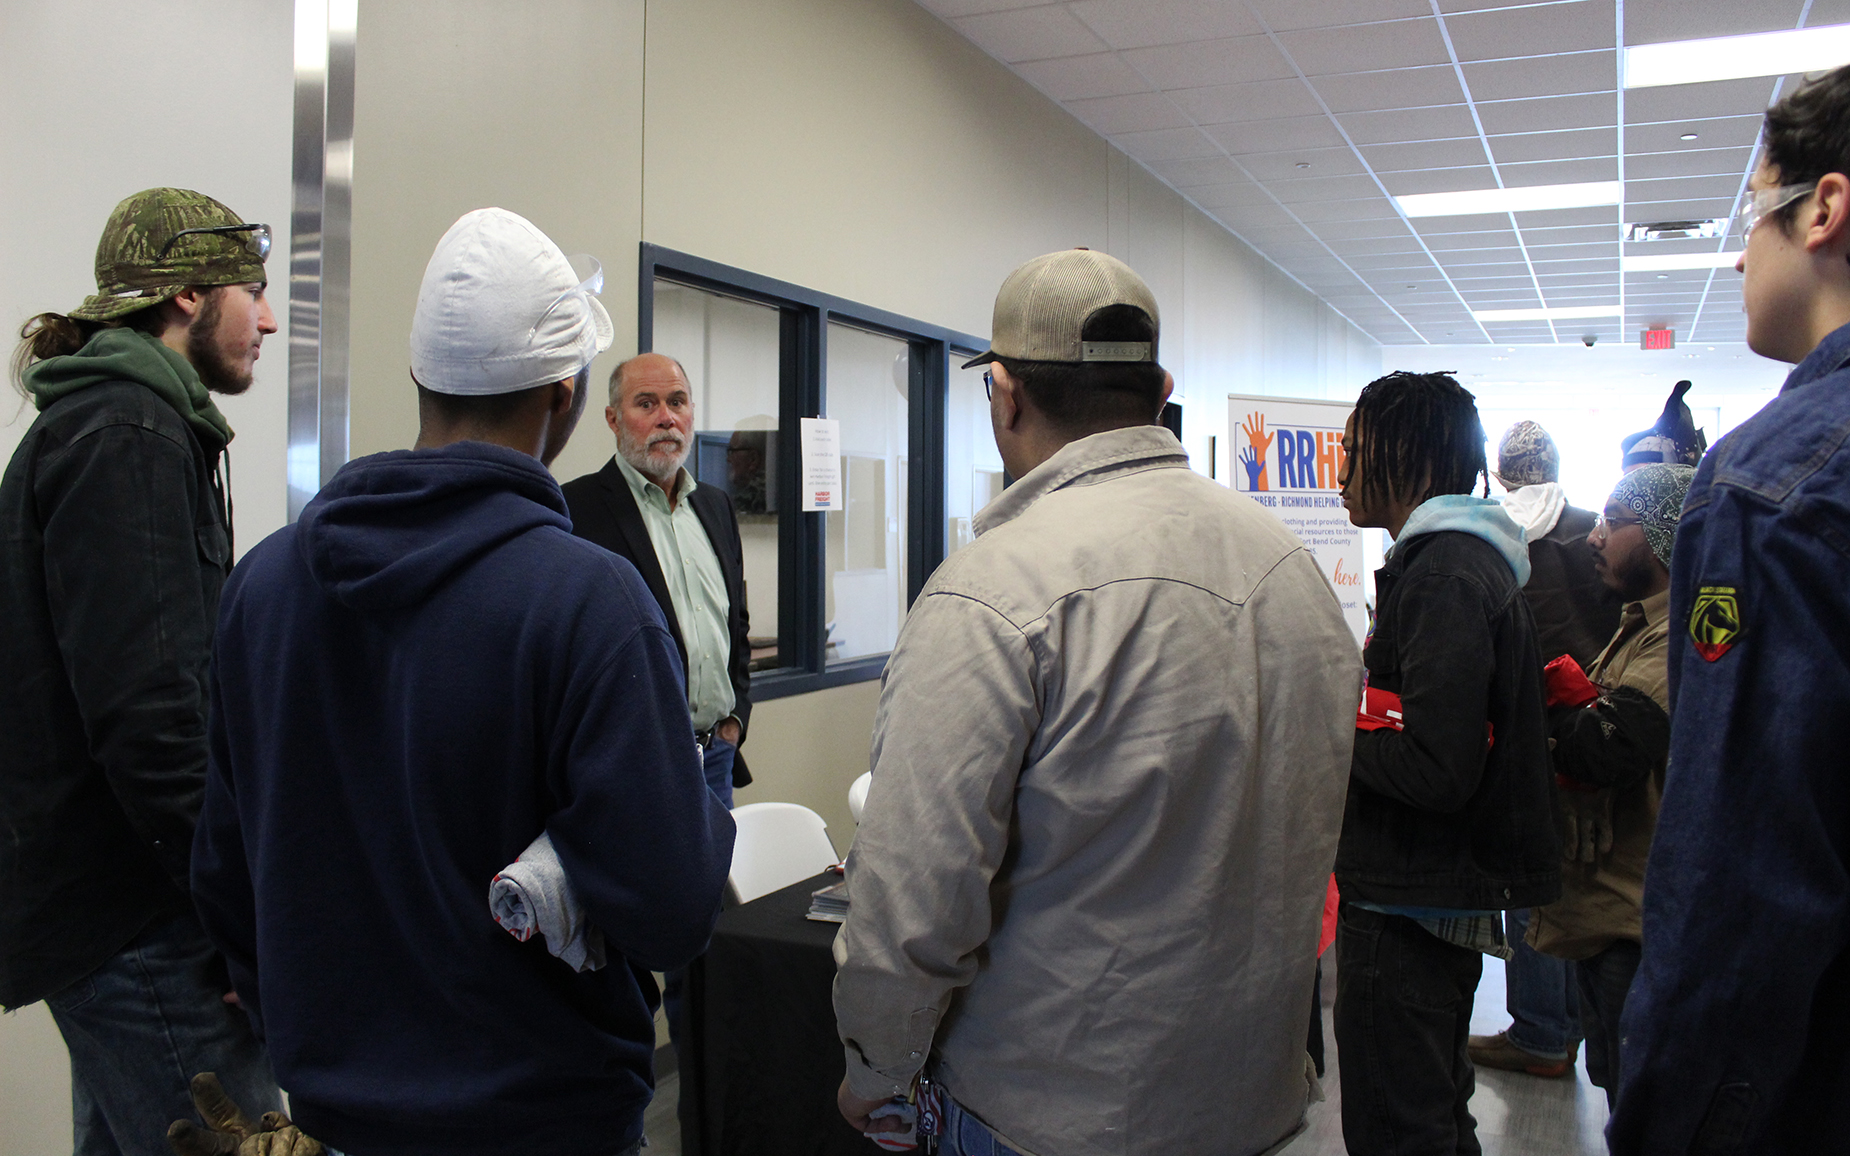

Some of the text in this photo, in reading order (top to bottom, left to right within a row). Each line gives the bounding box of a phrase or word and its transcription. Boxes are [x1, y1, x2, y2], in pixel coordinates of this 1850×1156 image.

[1646, 330, 1672, 349] EXIT
[1282, 496, 1312, 508] RICHMOND
[1314, 497, 1340, 508] HELPING
[1319, 518, 1348, 526] providing
[1330, 538, 1352, 546] County
[1334, 558, 1361, 586] here.
